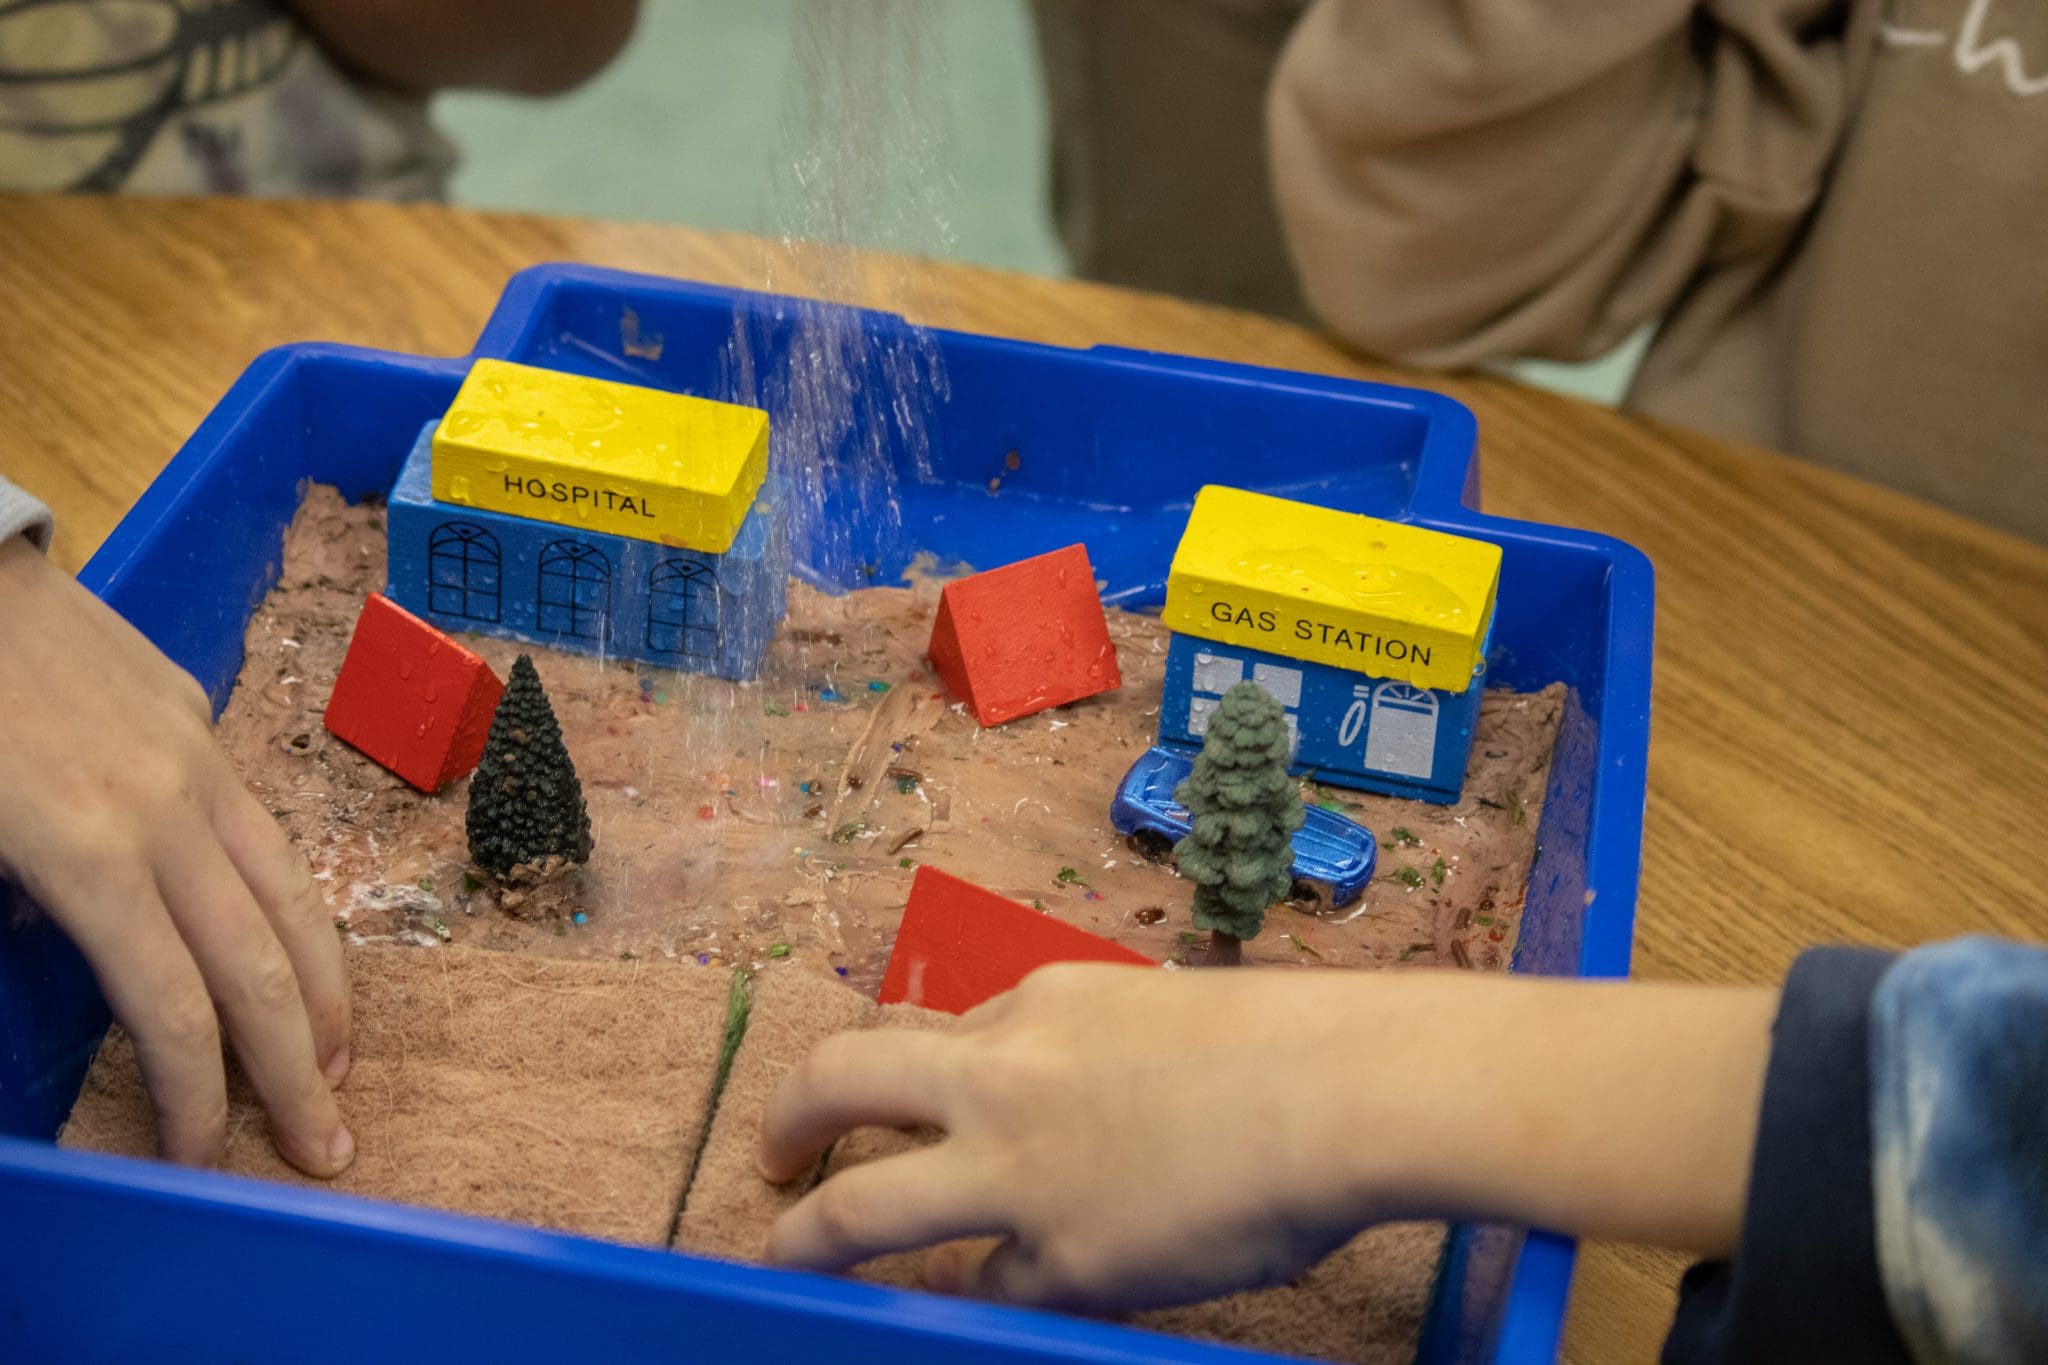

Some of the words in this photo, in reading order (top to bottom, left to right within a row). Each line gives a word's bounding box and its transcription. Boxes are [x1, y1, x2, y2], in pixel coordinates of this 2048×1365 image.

[504, 474, 656, 518] HOSPITAL
[1211, 602, 1276, 632] GAS
[1294, 619, 1432, 666] STATION
